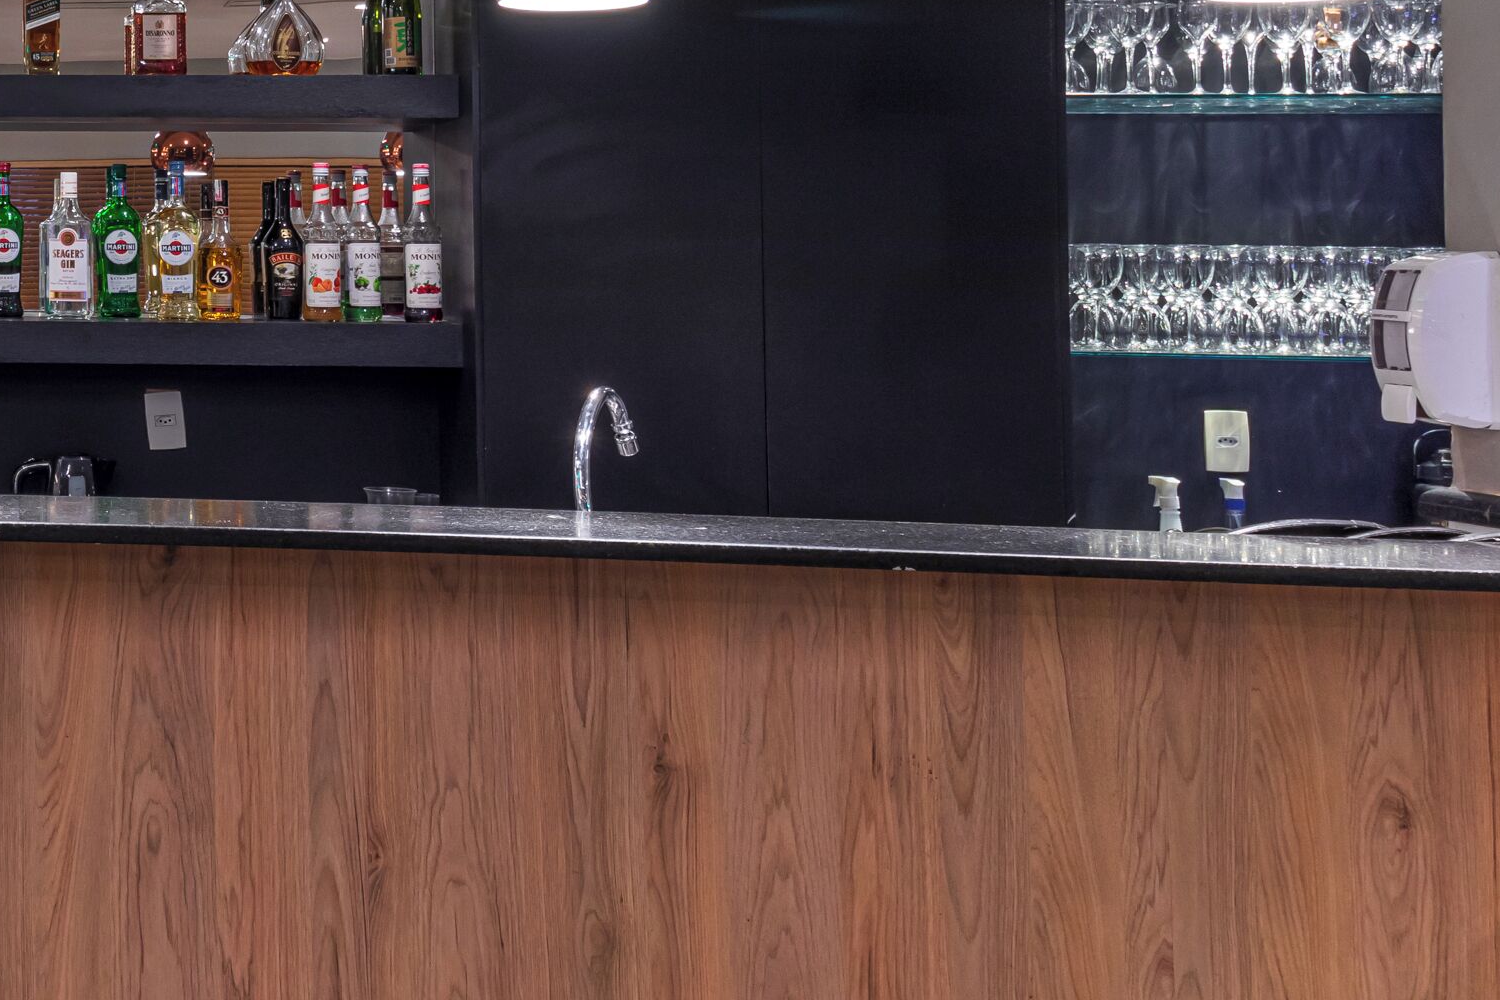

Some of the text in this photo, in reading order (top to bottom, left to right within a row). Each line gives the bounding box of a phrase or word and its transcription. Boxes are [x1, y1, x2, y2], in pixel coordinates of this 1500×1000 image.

[52, 249, 85, 259] SEAGERS
[60, 260, 75, 269] GIN
[211, 271, 228, 283] 43
